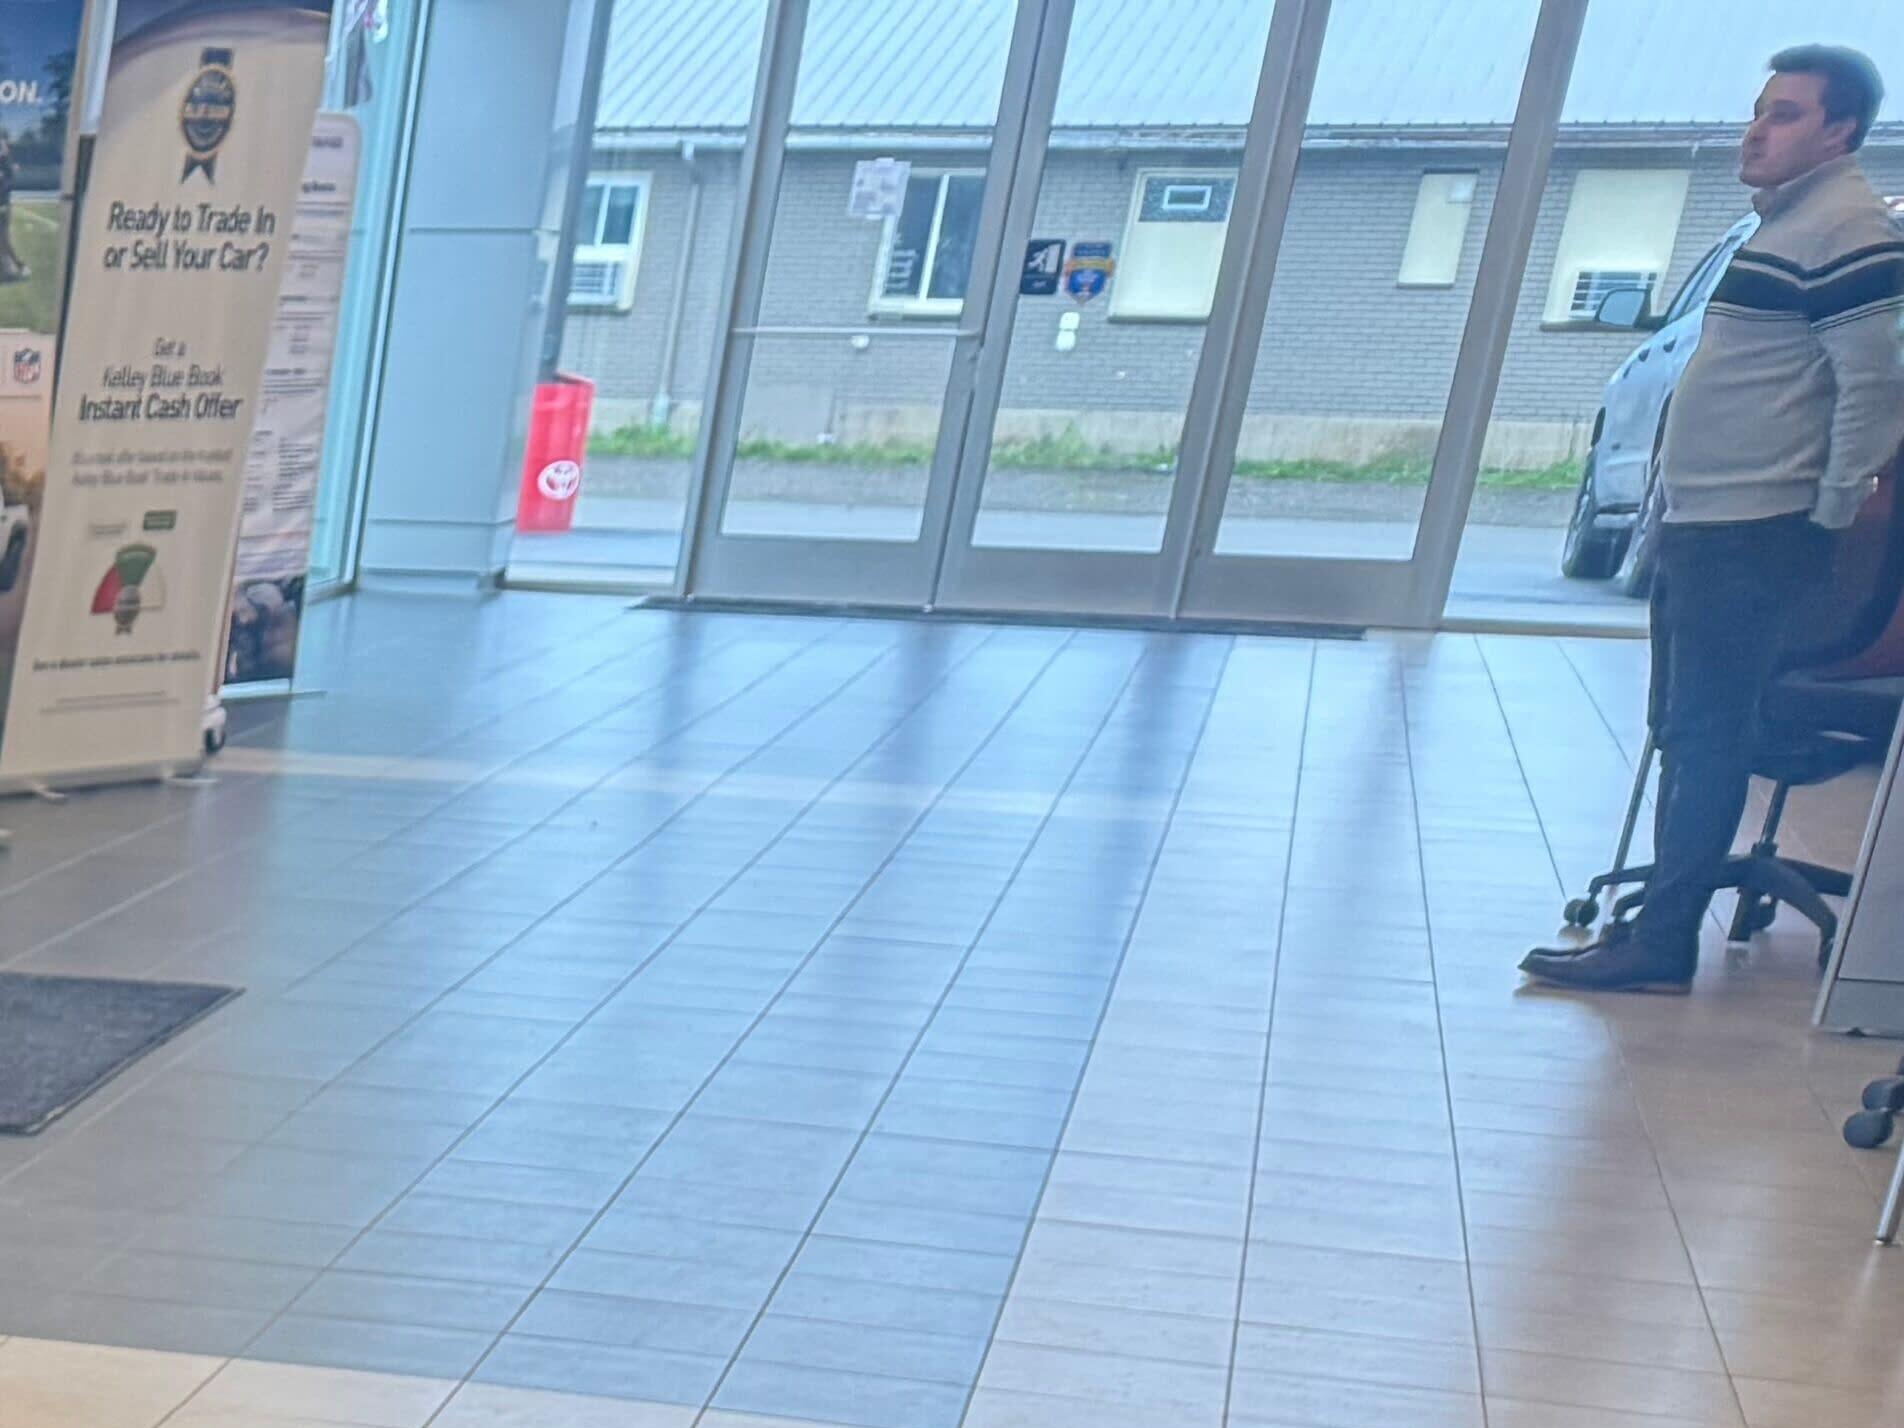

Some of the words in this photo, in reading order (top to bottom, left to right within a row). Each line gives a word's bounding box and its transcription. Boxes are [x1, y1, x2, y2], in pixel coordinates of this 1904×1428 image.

[107, 200, 170, 238] Ready
[173, 204, 191, 232] to
[198, 202, 252, 233] Trade
[255, 205, 276, 234] In
[103, 246, 128, 268] or
[130, 239, 168, 269] Sell
[174, 239, 217, 269] Your
[219, 241, 270, 272] Car?
[103, 365, 145, 391] Kelley
[150, 364, 185, 387] Blue
[187, 363, 224, 387] Book
[79, 392, 143, 421] Instant
[145, 392, 192, 420] Cash
[194, 392, 243, 420] Offer
